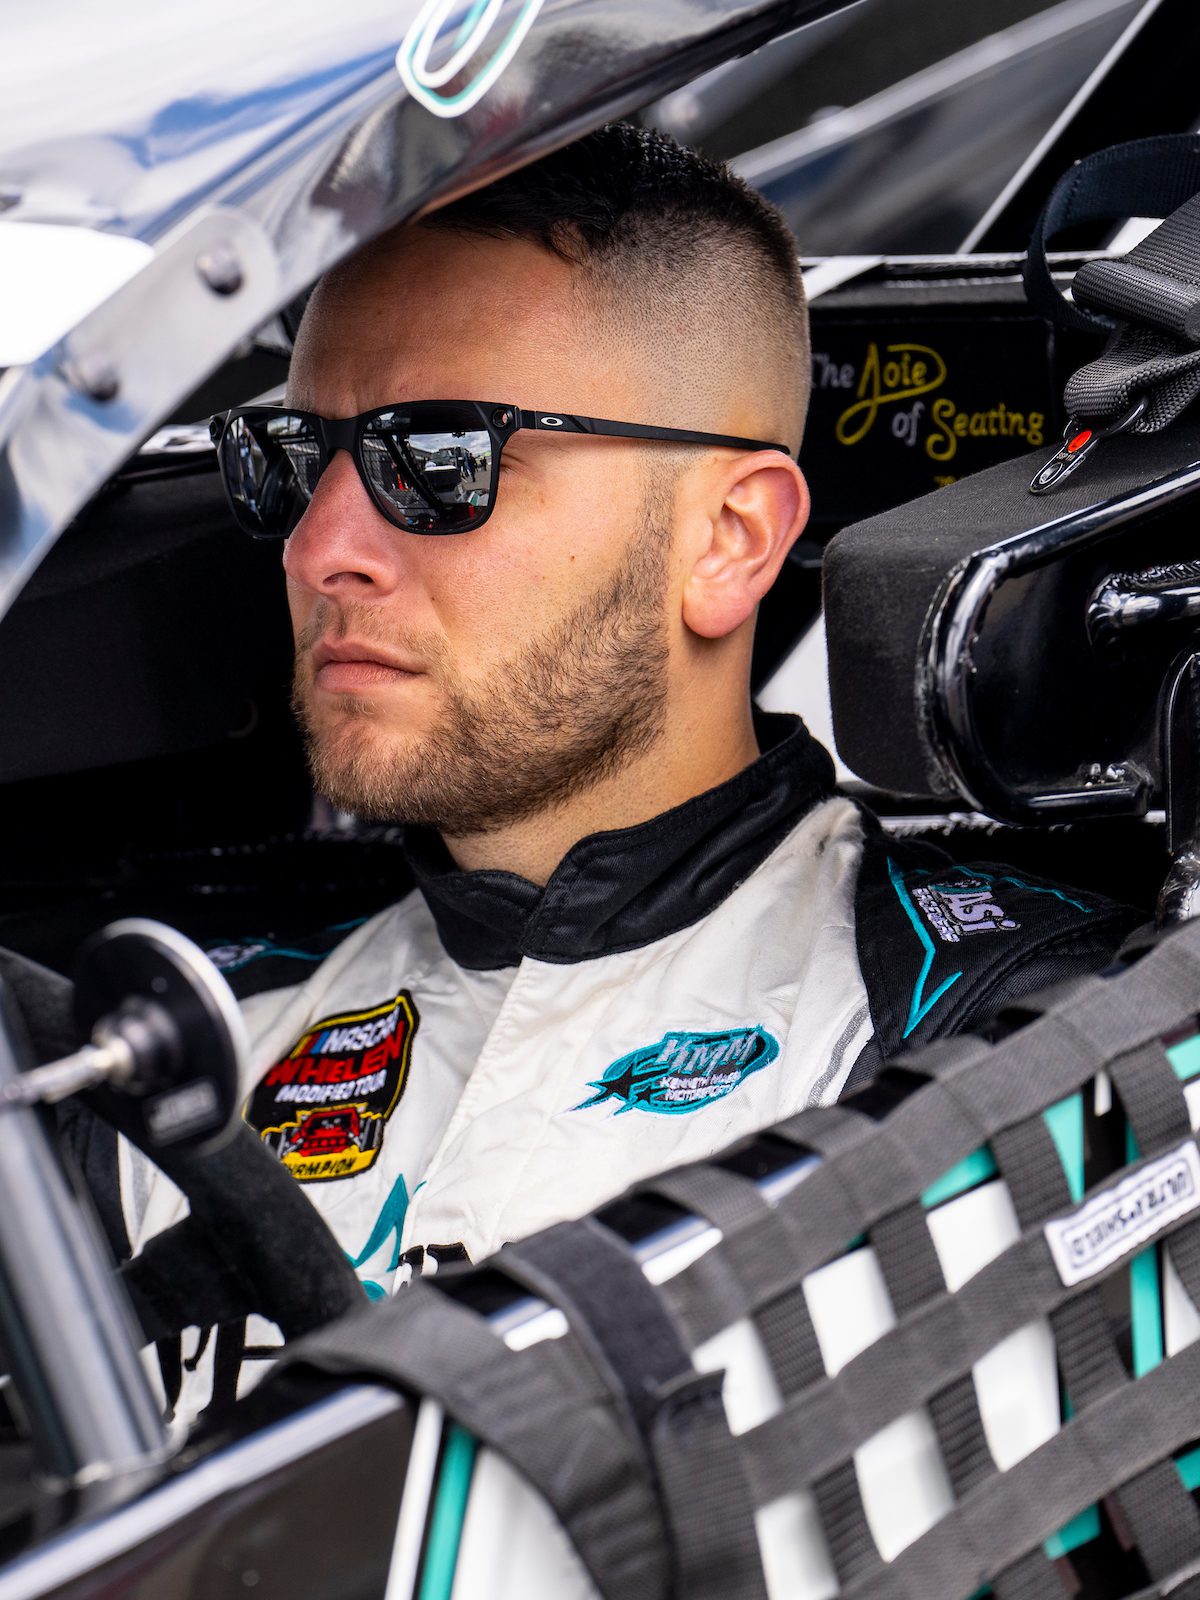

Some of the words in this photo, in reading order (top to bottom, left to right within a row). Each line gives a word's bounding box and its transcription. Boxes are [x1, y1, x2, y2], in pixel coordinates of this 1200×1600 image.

[891, 401, 926, 447] of
[926, 399, 1045, 461] Seating
[265, 1020, 404, 1086] WHELEN
[656, 1031, 760, 1076] KMM
[274, 1081, 355, 1104] MODIFIED
[354, 1069, 387, 1097] TOUR
